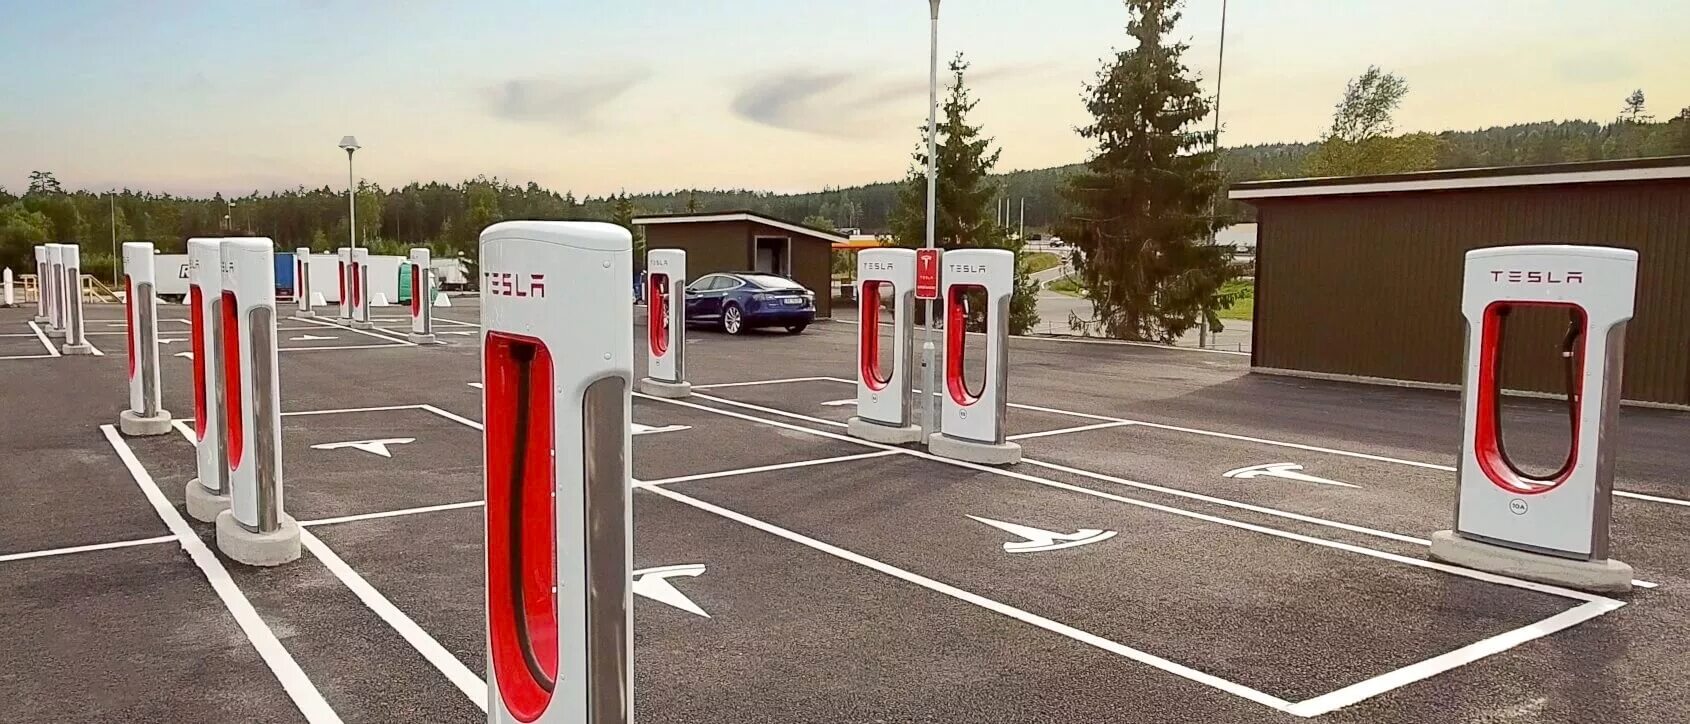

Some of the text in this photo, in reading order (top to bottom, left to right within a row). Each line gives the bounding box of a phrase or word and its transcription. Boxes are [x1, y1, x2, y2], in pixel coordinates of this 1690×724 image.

[863, 262, 893, 270] TESLA
[949, 264, 986, 273] TESLA
[1490, 270, 1583, 283] TESLA
[484, 272, 545, 298] TESLA
